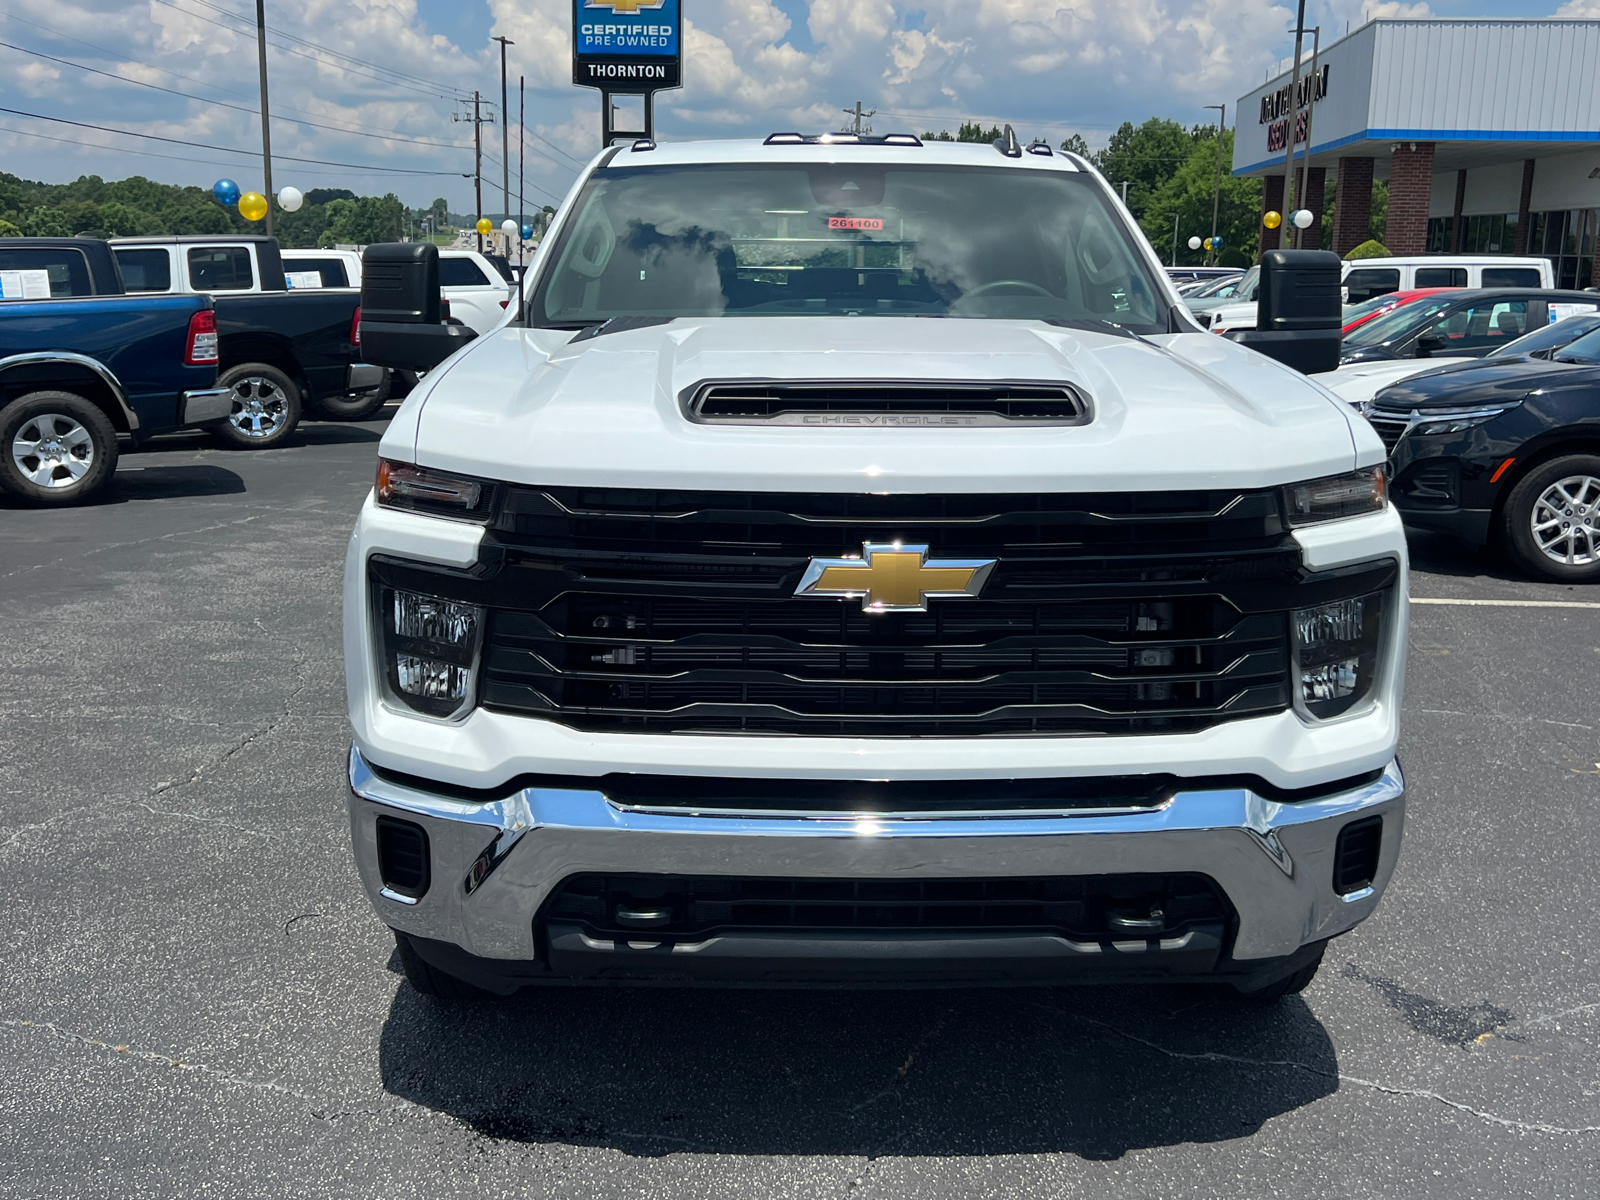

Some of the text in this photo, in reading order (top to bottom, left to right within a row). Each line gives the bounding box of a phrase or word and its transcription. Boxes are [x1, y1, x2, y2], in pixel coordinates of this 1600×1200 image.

[581, 24, 672, 36] CERTIFIED
[585, 36, 668, 46] PRE-OWNED
[588, 64, 665, 78] THORNTON
[831, 219, 879, 229] 261100
[803, 415, 977, 425] CHEVROLET
